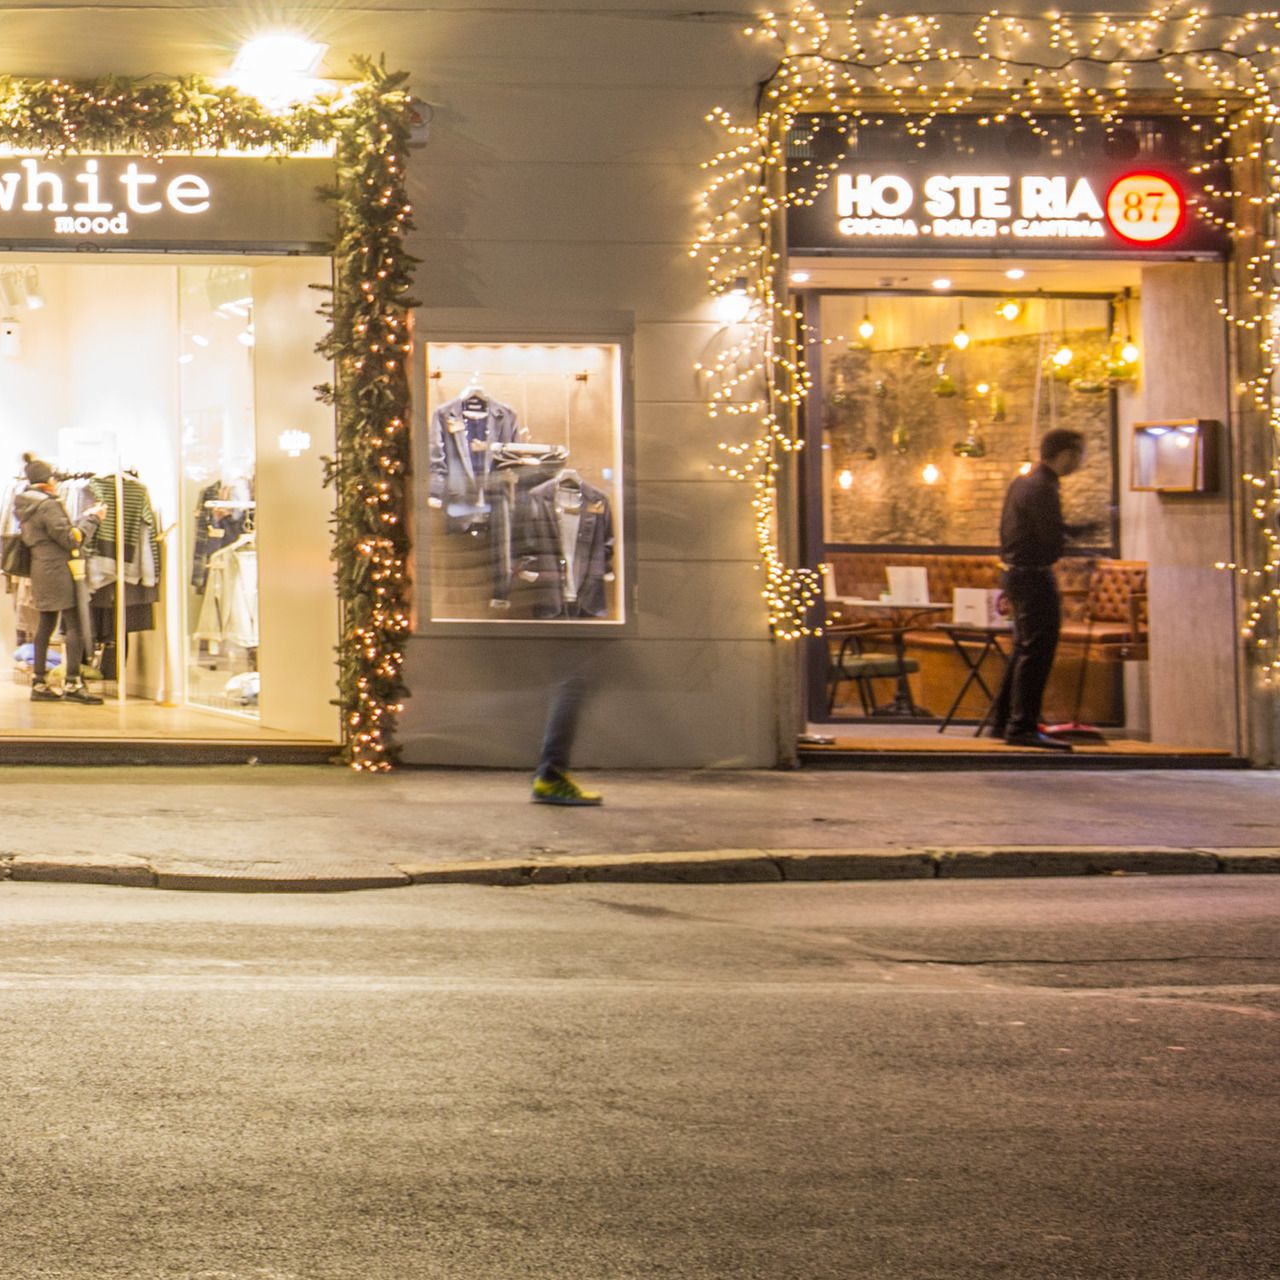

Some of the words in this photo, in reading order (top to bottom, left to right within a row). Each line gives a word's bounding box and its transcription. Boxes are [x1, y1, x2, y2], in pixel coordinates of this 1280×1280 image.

[837, 174, 914, 218] HO
[924, 175, 1011, 219] STE
[1021, 176, 1105, 219] RIA
[1123, 191, 1166, 223] 87
[54, 212, 129, 234] mood
[838, 219, 918, 237] CUCINA
[933, 219, 997, 237] DOLCI
[1012, 220, 1105, 237] CANTINA
